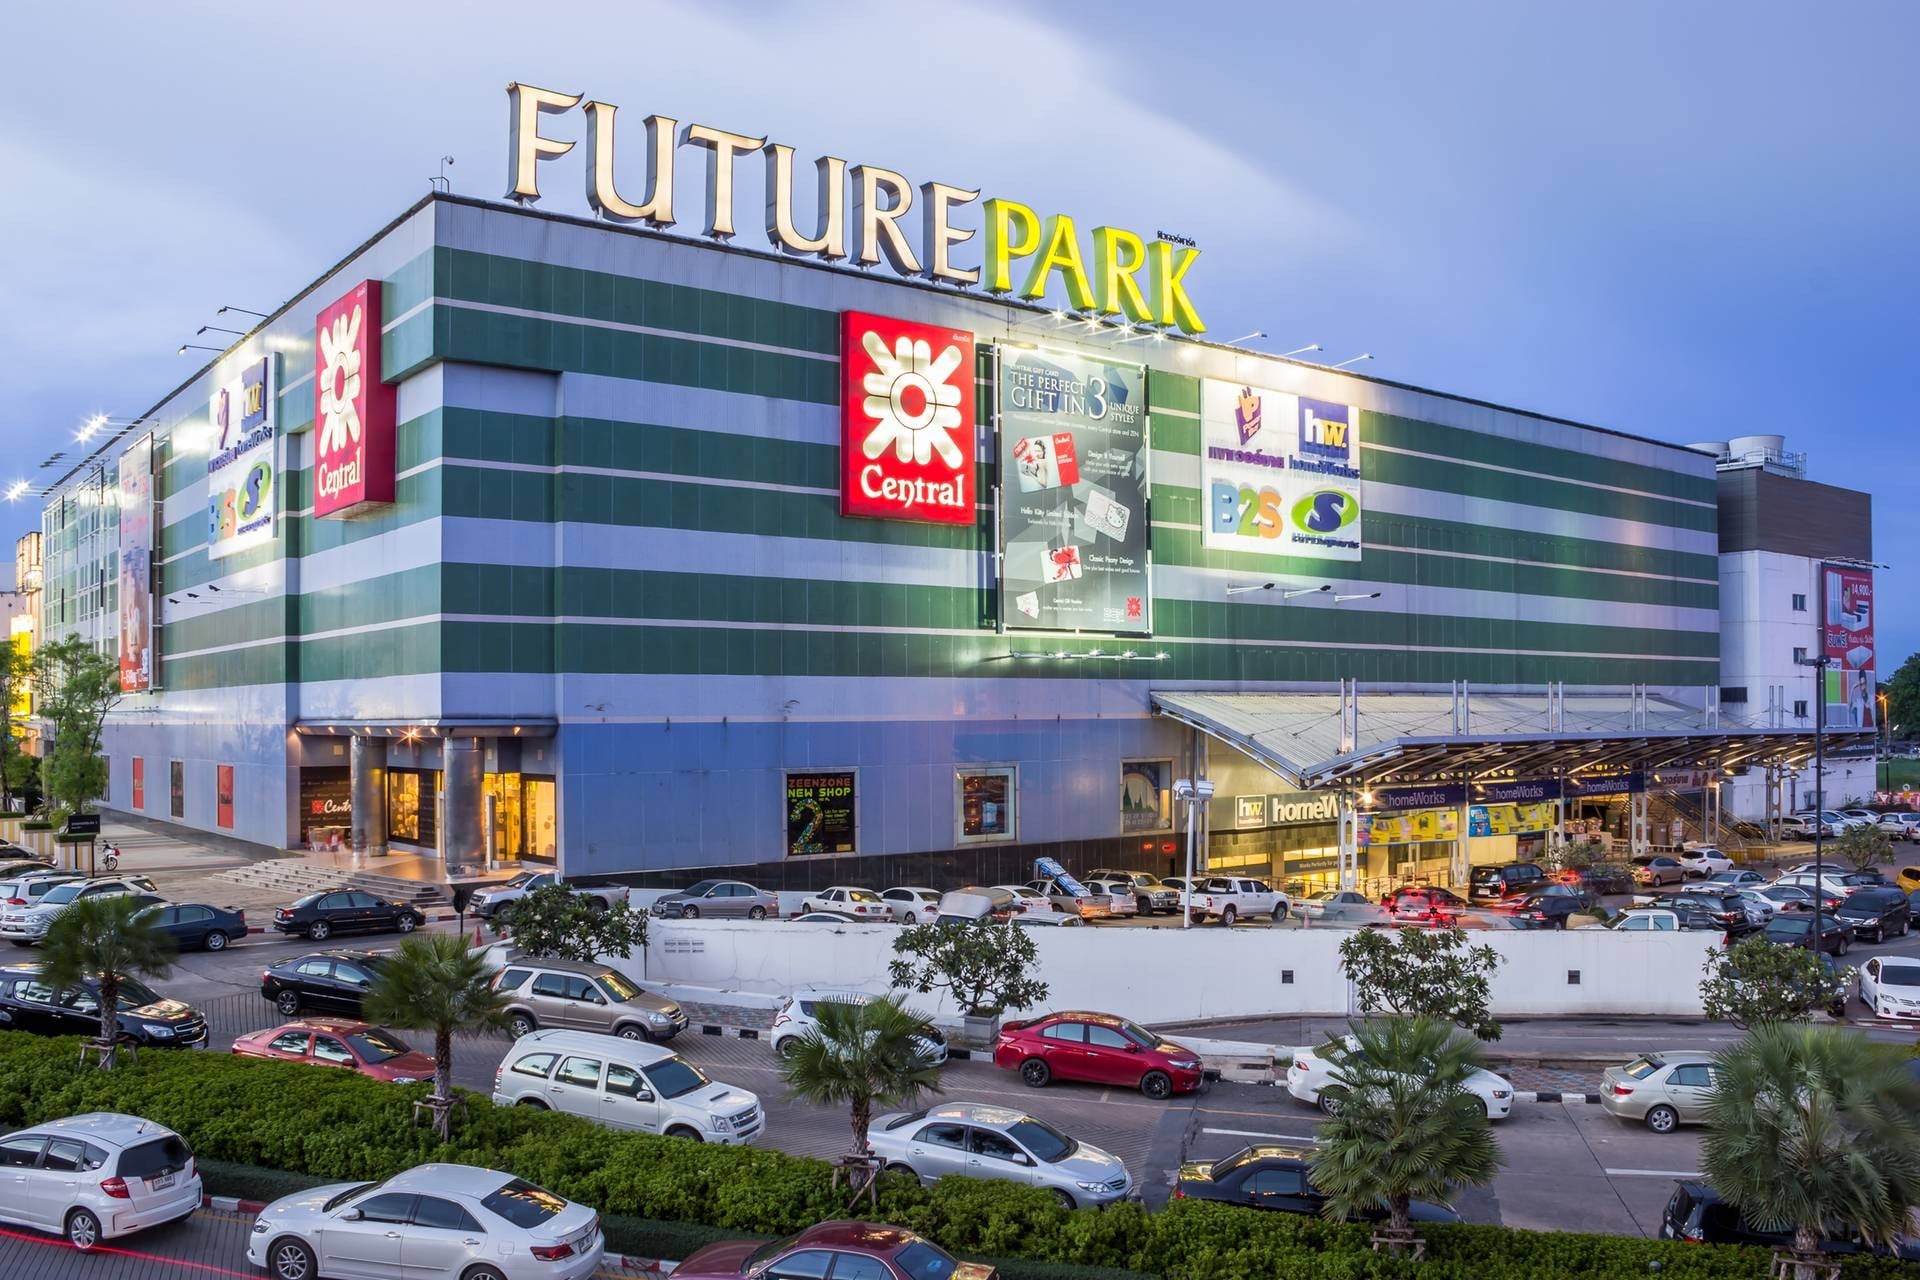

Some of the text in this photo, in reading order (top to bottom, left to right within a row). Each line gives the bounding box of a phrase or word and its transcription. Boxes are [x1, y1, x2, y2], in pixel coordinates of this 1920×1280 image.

[505, 82, 981, 288] FUTURE
[983, 198, 1207, 334] PARK
[1011, 371, 1086, 395] THE PERFECT
[1011, 387, 1085, 416] GIFT IN
[1089, 377, 1107, 420] 3
[1110, 402, 1140, 415] UNIQUE
[1110, 414, 1135, 424] STYLES
[318, 447, 361, 498] Central
[1289, 454, 1360, 480] homeWorks
[861, 463, 965, 508] Central
[1212, 482, 1284, 540] B2S
[1307, 491, 1345, 533] S
[788, 777, 851, 788] ZEENZONE
[788, 787, 852, 798] NEW SHOP
[1495, 785, 1544, 799] homeWorks
[1586, 779, 1630, 793] homeWorks
[1389, 792, 1445, 807] homeWorks
